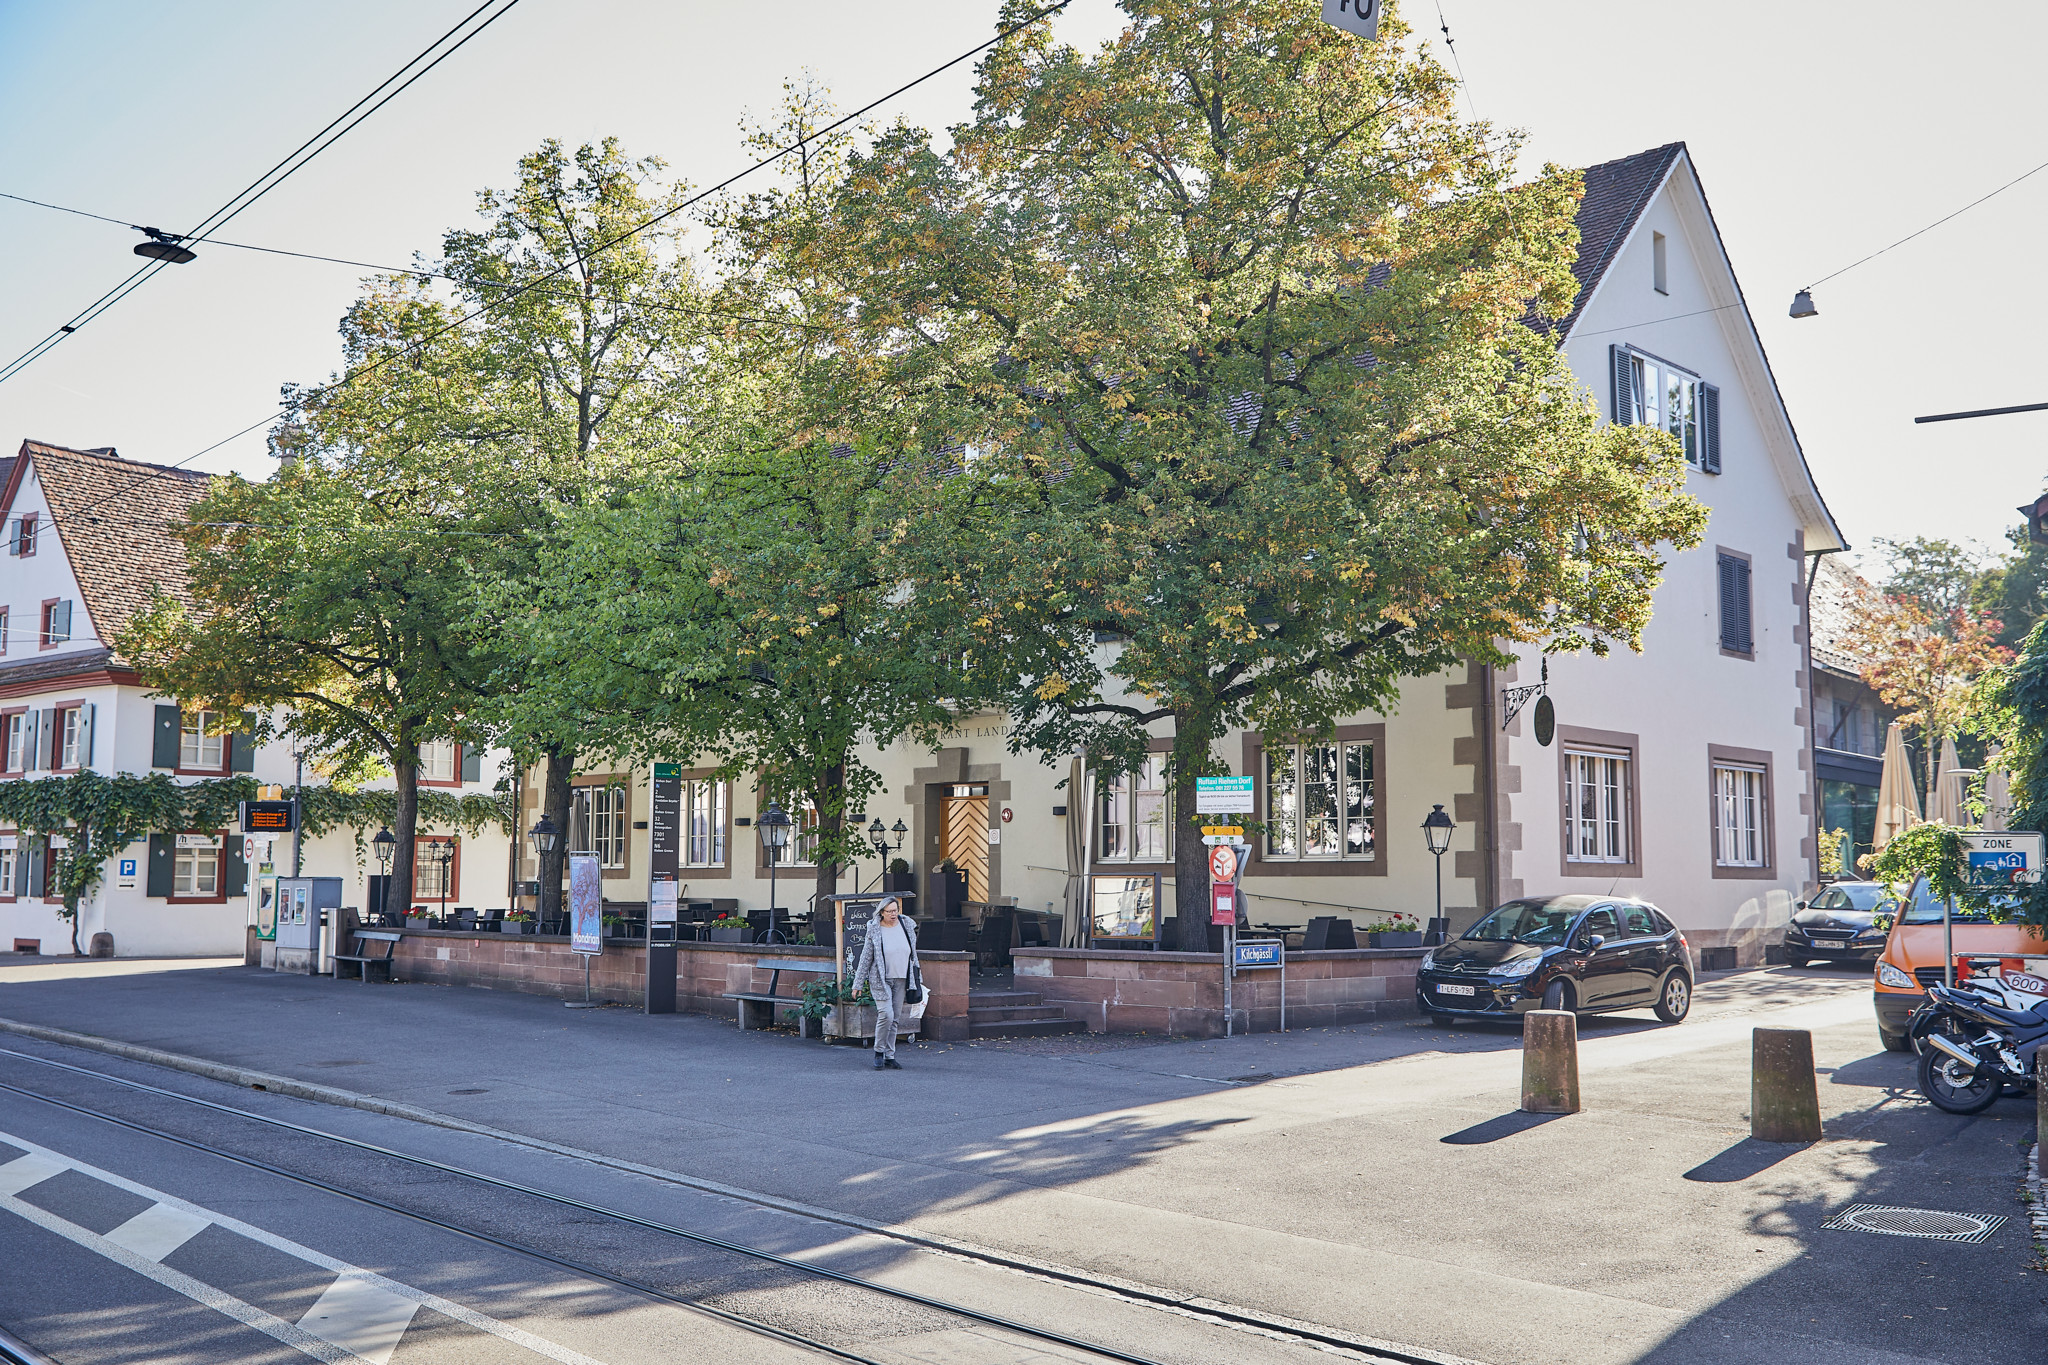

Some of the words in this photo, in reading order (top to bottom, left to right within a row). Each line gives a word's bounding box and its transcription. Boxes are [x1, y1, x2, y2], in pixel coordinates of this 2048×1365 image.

[1983, 840, 2012, 848] ZONE
[573, 932, 600, 944] Mondrian
[1241, 948, 1272, 961] Kilchgässli
[2012, 976, 2039, 991] 600
